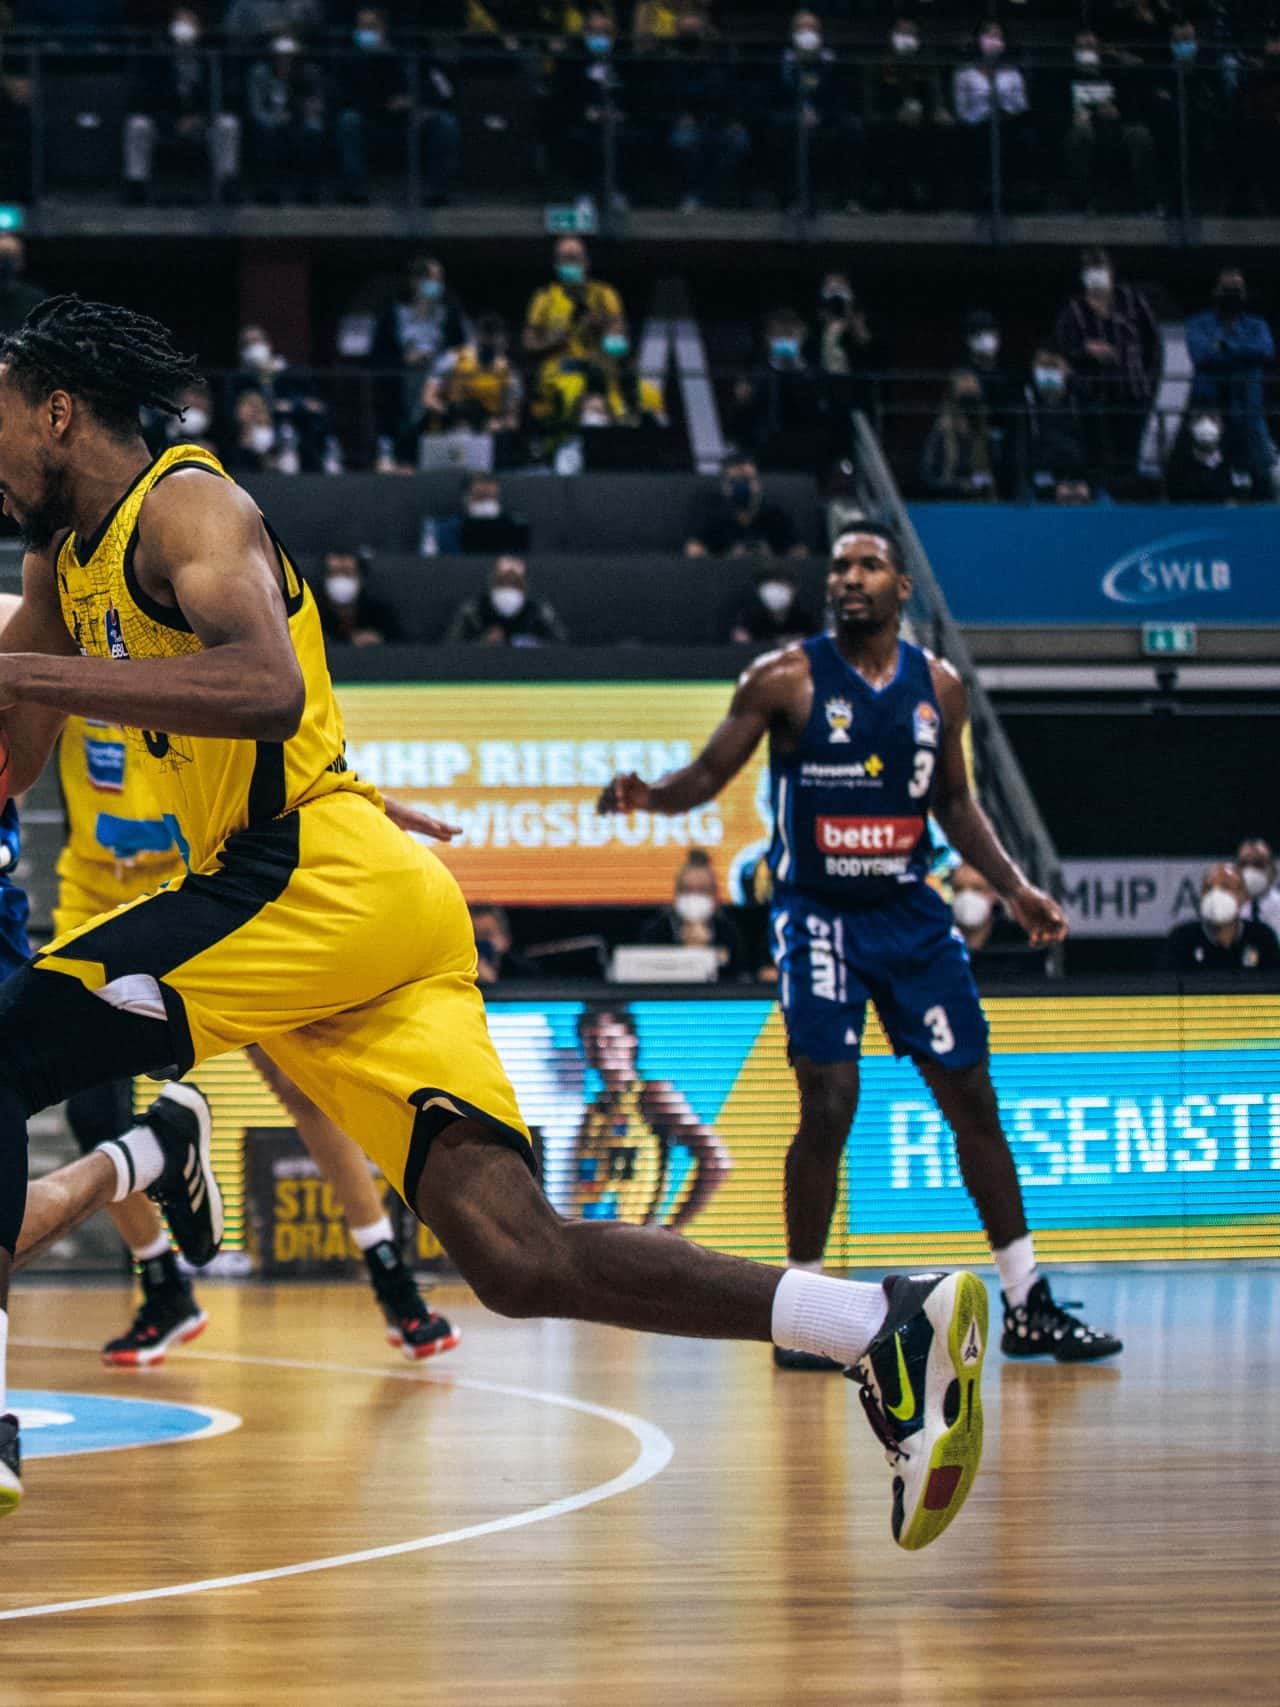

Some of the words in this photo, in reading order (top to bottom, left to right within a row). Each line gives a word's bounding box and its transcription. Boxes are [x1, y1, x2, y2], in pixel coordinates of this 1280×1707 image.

[1140, 560, 1231, 591] SWLB
[478, 740, 691, 788] RIESEN
[908, 749, 936, 798] 3
[1058, 876, 1157, 919] MHP
[923, 1004, 955, 1055] 3
